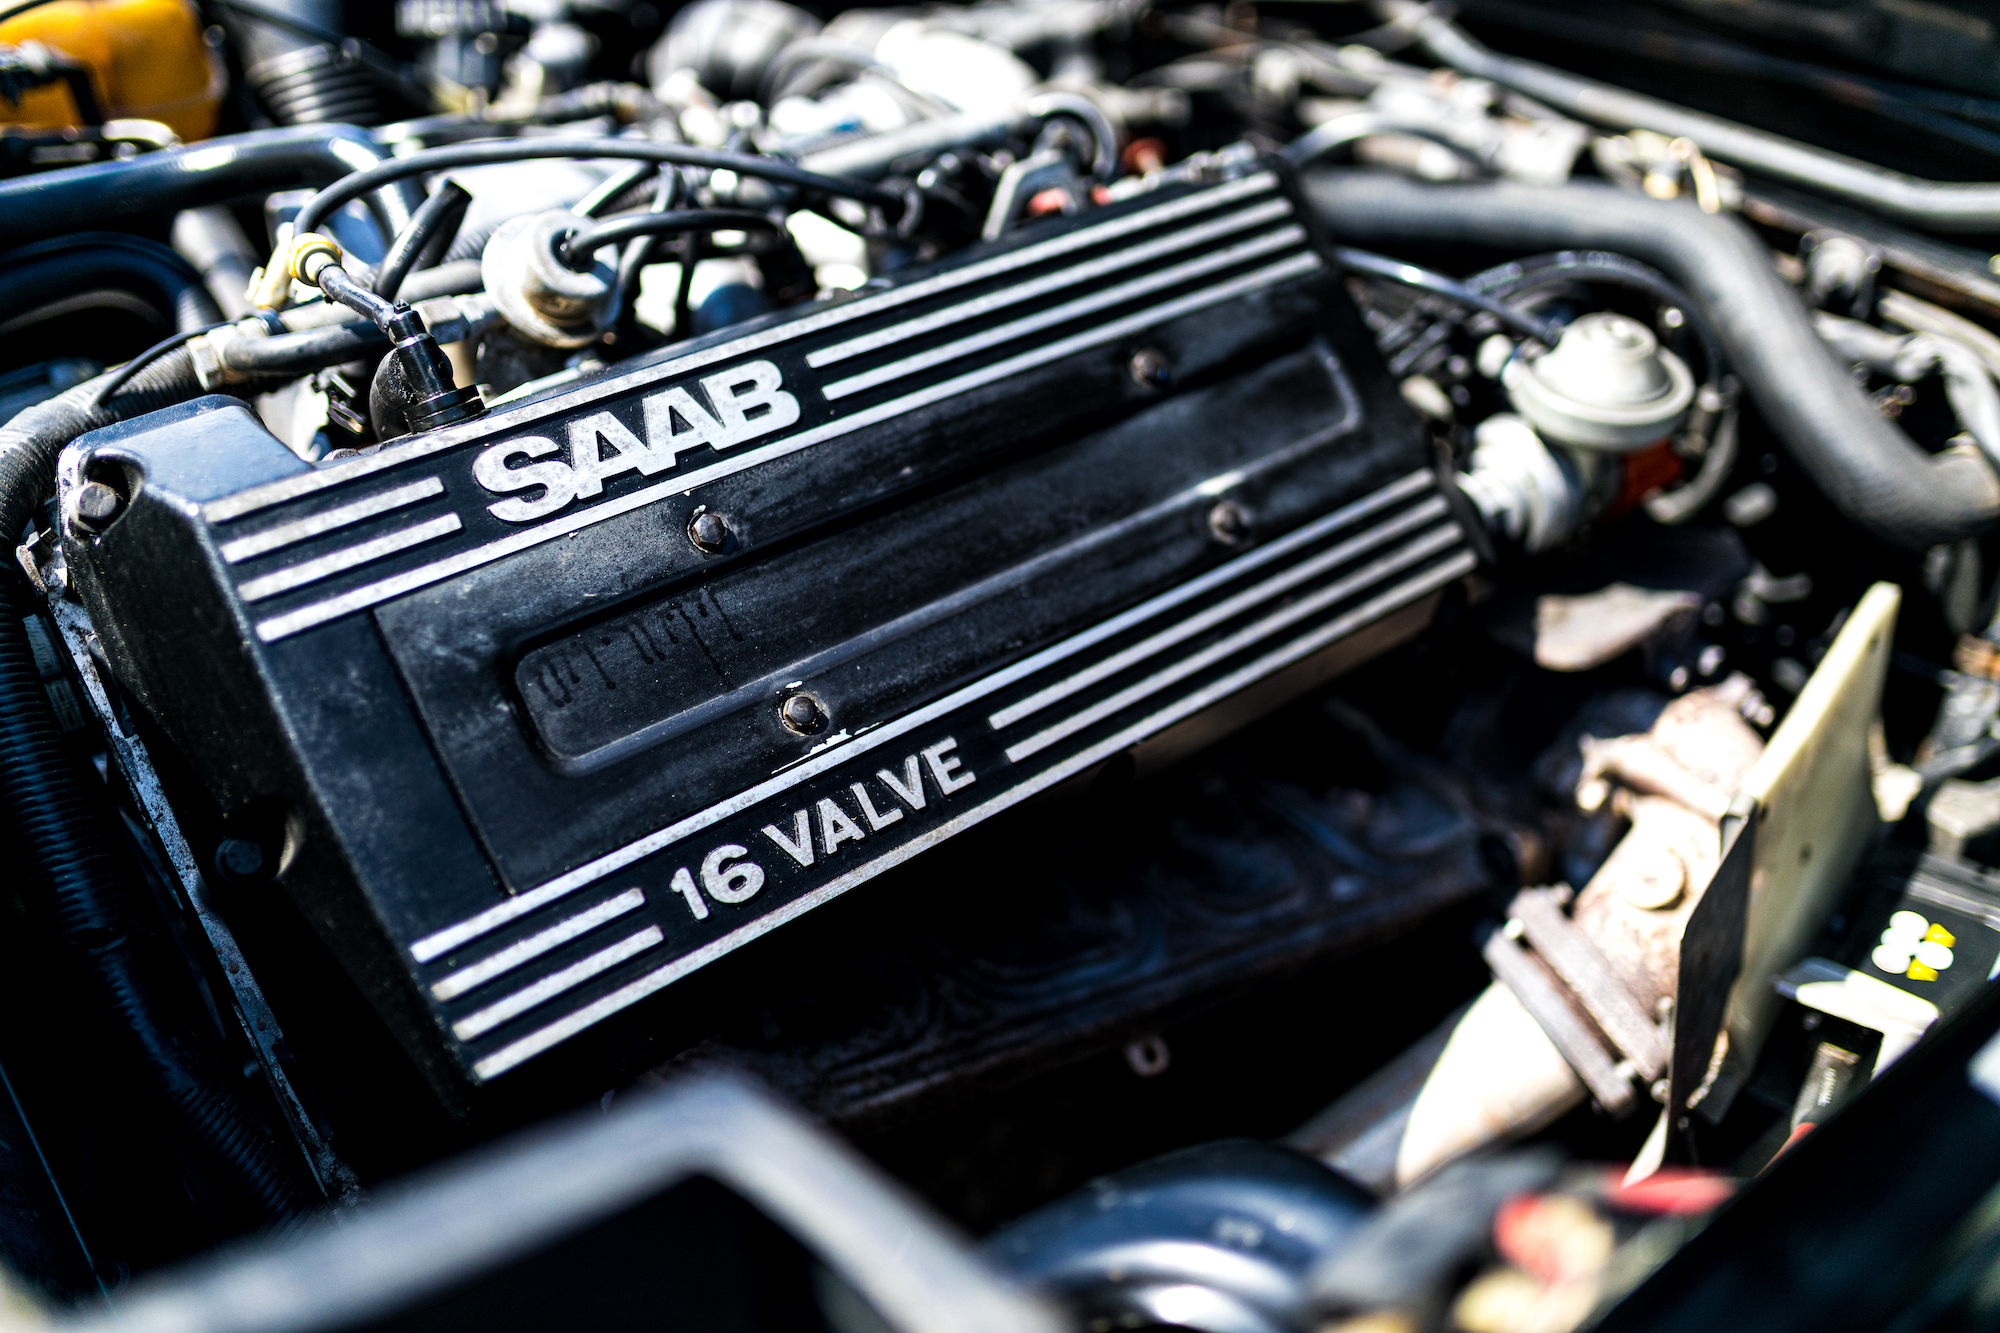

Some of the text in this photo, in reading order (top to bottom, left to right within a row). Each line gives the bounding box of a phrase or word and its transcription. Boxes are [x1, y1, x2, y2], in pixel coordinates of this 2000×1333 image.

[472, 359, 801, 522] SAAB
[669, 737, 977, 920] 16 VALVE
